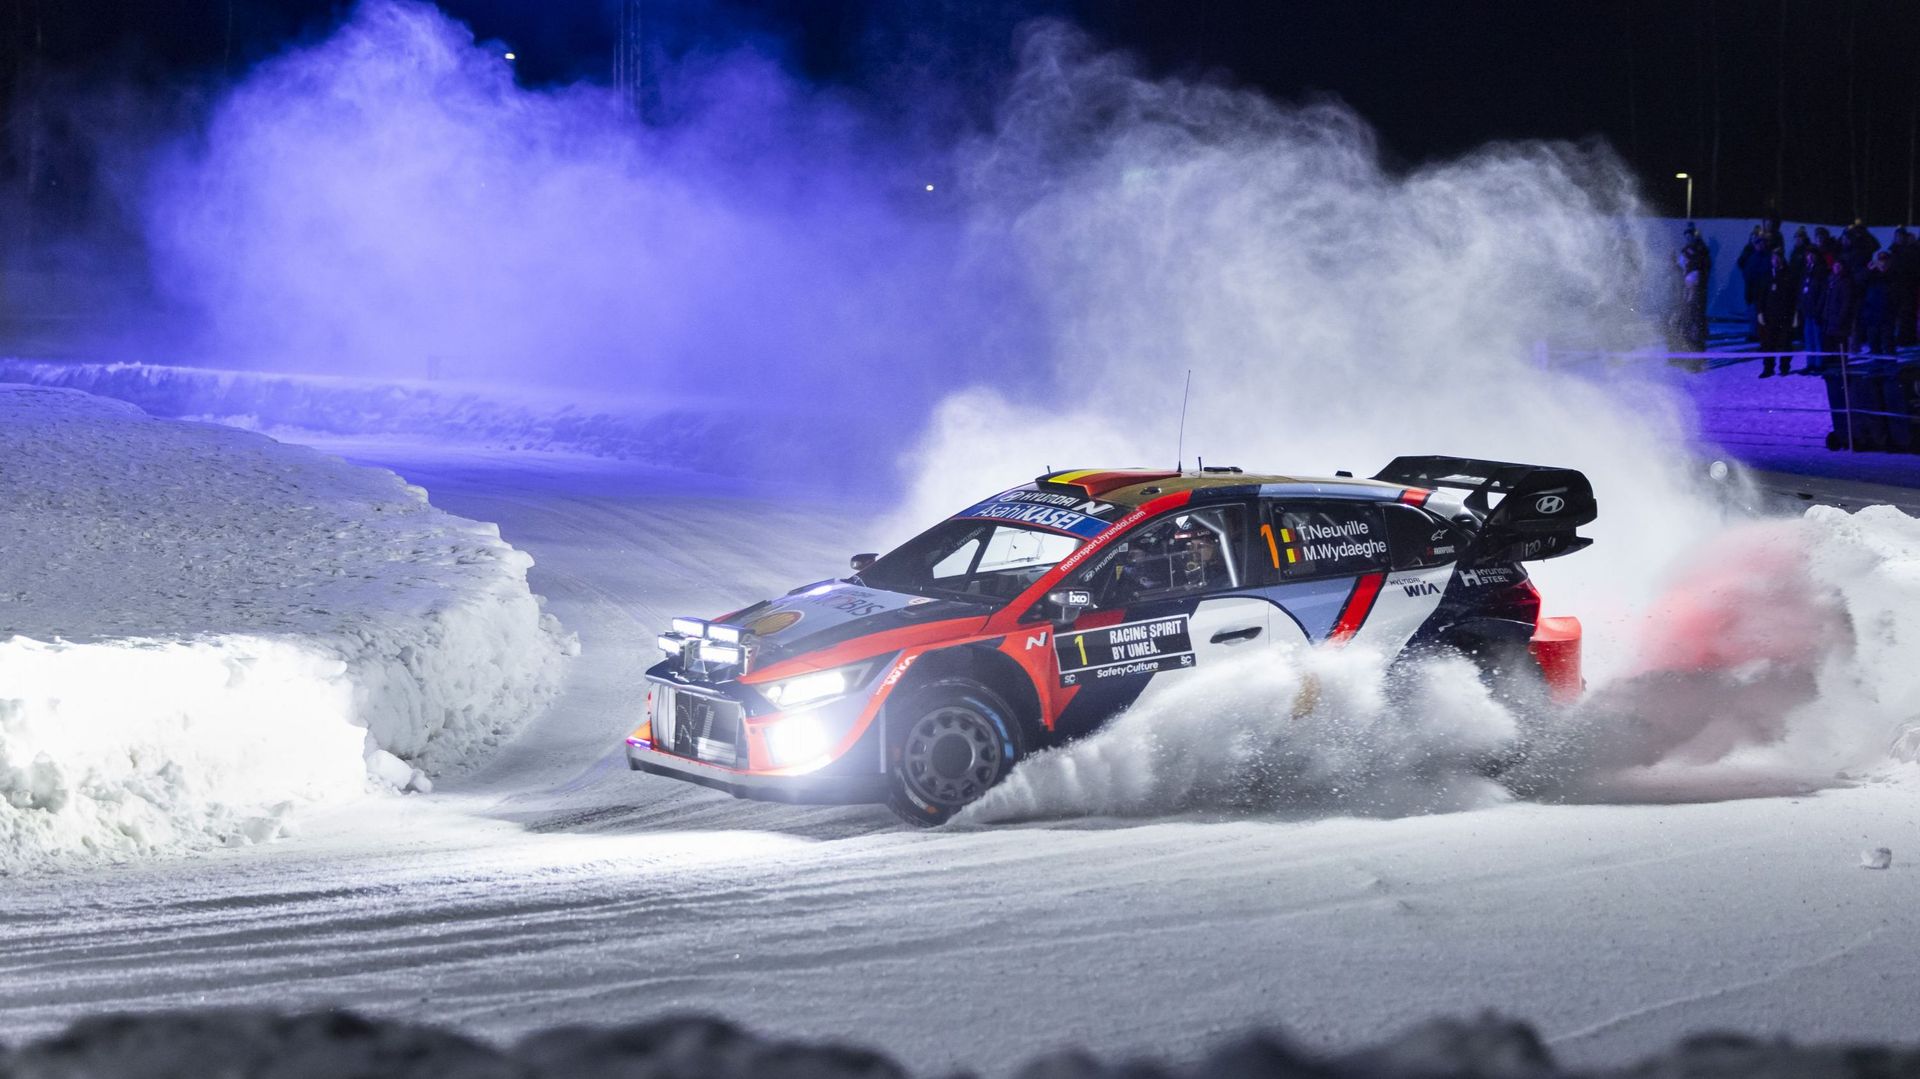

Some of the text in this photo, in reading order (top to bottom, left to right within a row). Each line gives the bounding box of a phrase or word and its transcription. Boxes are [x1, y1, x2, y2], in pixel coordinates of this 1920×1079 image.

[1022, 492, 1080, 507] HYUNDAI
[1296, 520, 1369, 541] T.Neuville
[1059, 509, 1147, 573] motorsport.hyundai.com
[1260, 523, 1280, 569] 1
[1303, 539, 1387, 562] M.Wydaeghe
[1481, 575, 1510, 585] STEEL
[1109, 620, 1182, 645] RACING SPIRIT
[1074, 635, 1088, 666] 1
[1112, 645, 1126, 661] BY
[1097, 661, 1159, 678] SafetyCulture
[1180, 655, 1192, 666] SC
[1064, 674, 1076, 684] SC
